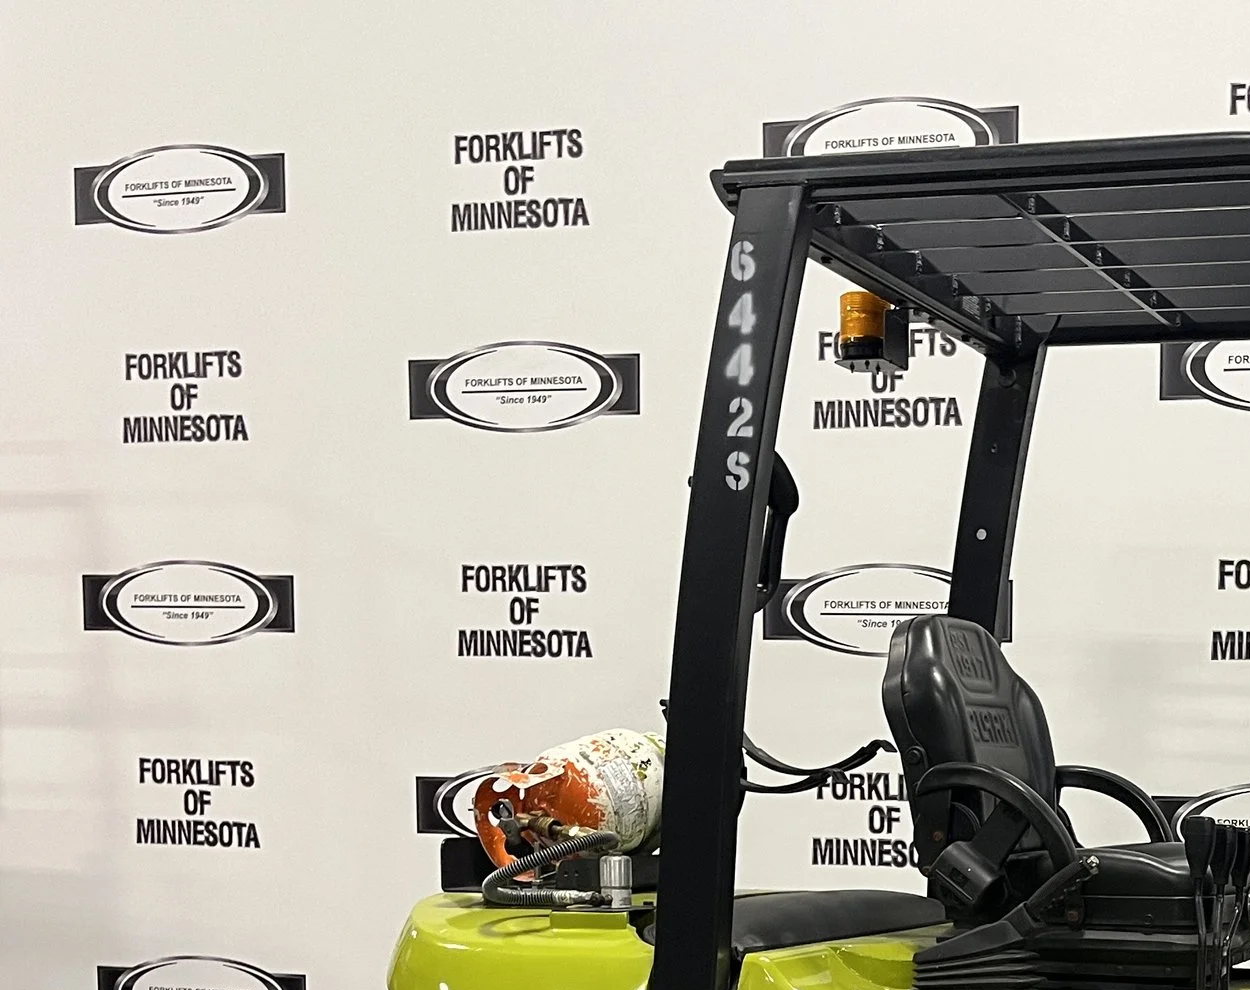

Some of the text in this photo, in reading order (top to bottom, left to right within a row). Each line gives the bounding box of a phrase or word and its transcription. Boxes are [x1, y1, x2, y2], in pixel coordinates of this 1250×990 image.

[455, 129, 582, 164] FORKLIFTS
[825, 133, 955, 150] FORKLIFTS OF MINNESOTA
[124, 176, 233, 192] FORKLIFTS OF MINNESOTA
[504, 166, 534, 195] OF
[452, 198, 589, 232] MINNESOTA
[126, 351, 241, 380] FORKLIFTS
[465, 375, 583, 387] FORKLIFTS OF MINNESOTA
[171, 384, 198, 410] OF
[814, 397, 962, 429] MINNESOTA
[123, 415, 248, 443] MINNESOTA
[462, 565, 586, 592] FORKLIFTS
[133, 594, 242, 603] FORKLIFTS OF MINNESOTA
[510, 597, 539, 625] OF
[824, 600, 877, 609] FORKLIFTS
[878, 600, 892, 610] OF
[458, 630, 592, 657] MINNESOTA
[139, 758, 254, 787] FORKLIFTS
[184, 789, 211, 815] OF
[137, 819, 260, 848] MINNESOTA
[869, 805, 900, 834] OF
[812, 837, 919, 868] MINNESO
